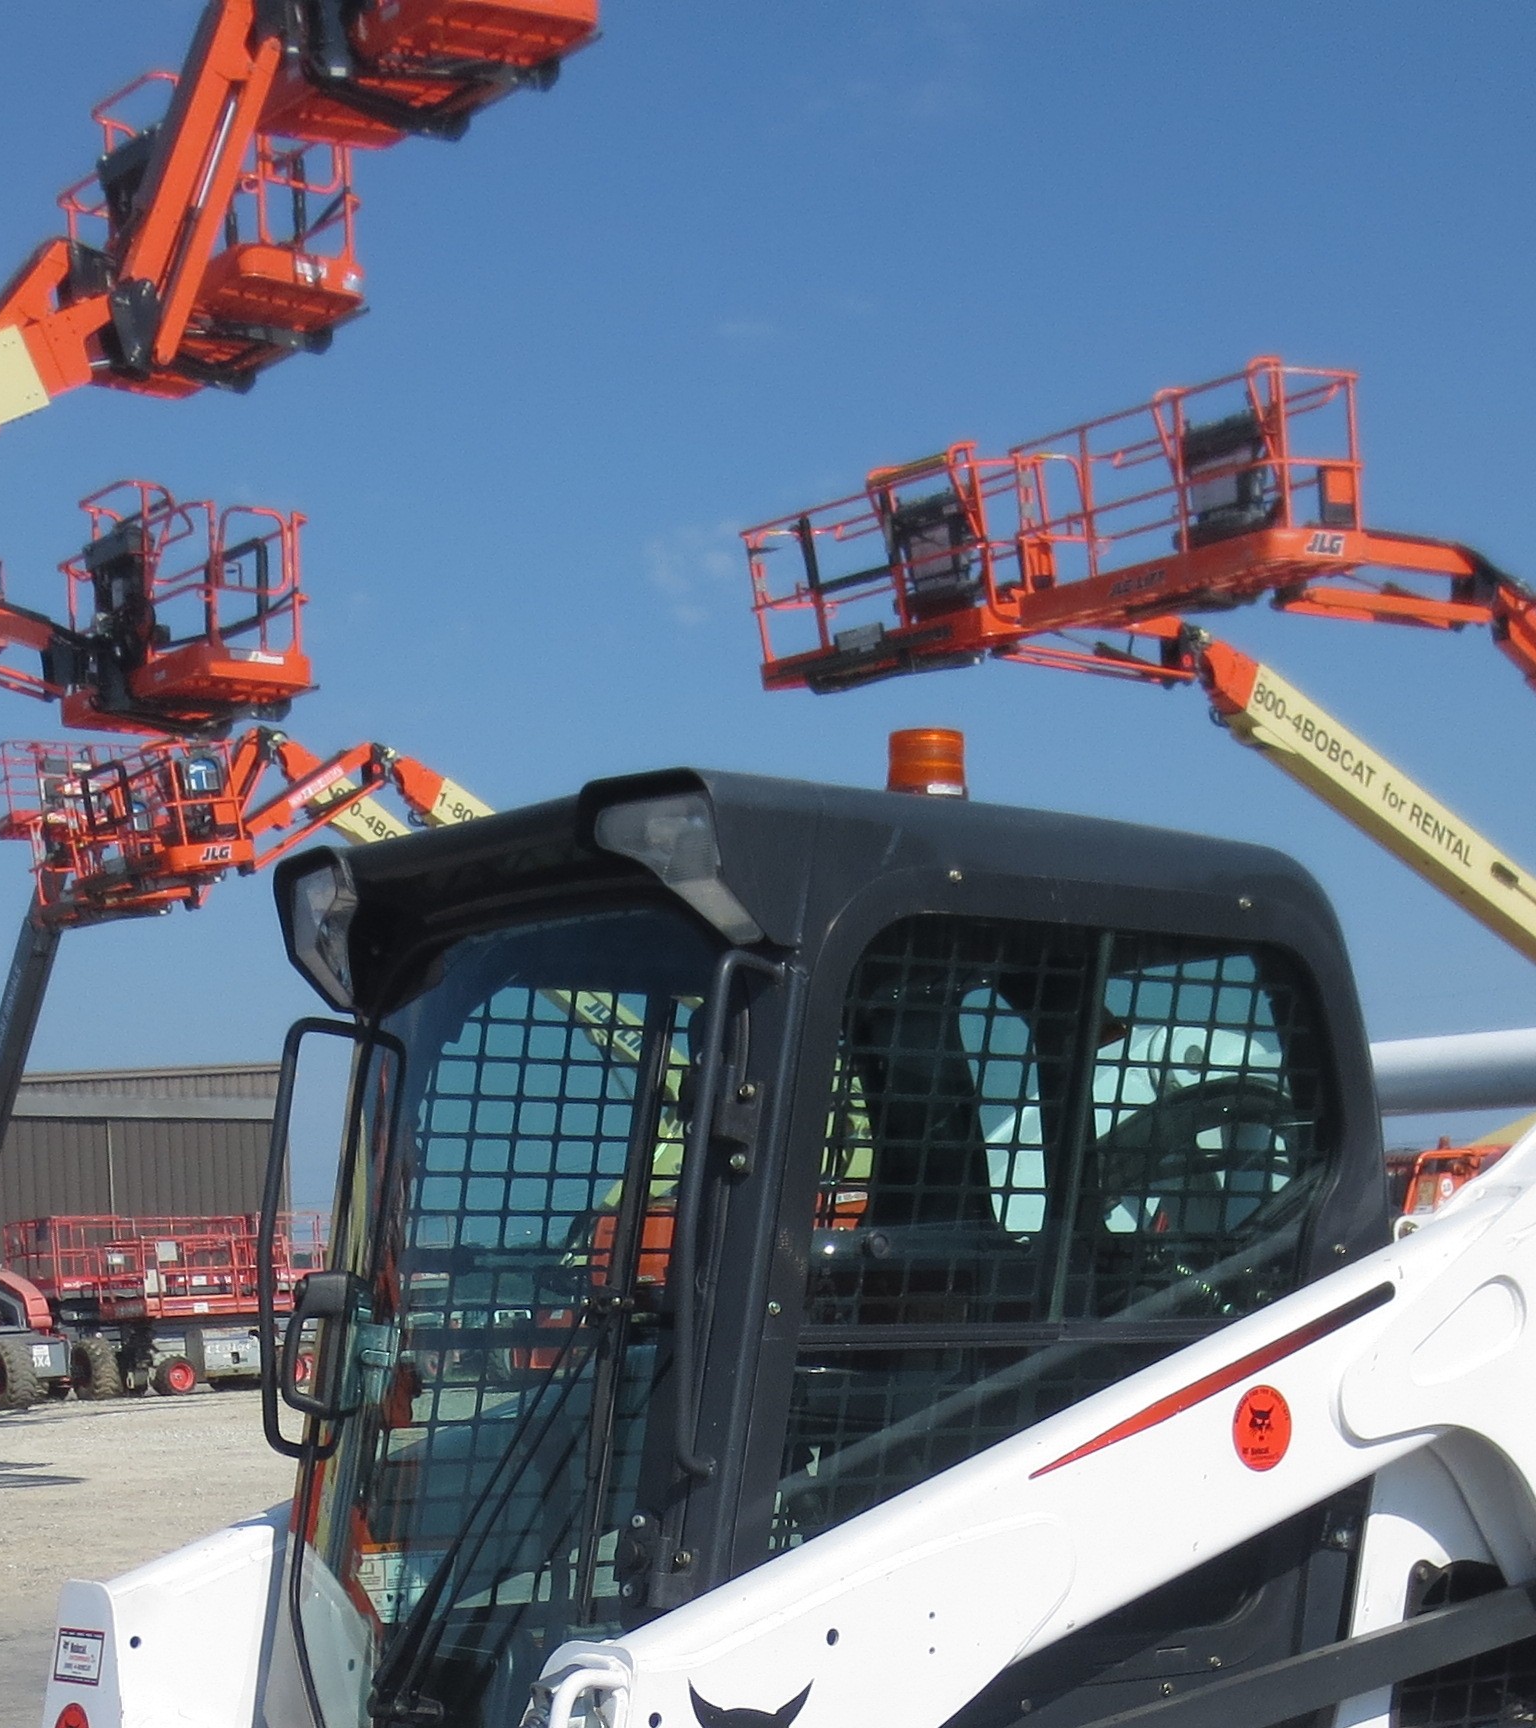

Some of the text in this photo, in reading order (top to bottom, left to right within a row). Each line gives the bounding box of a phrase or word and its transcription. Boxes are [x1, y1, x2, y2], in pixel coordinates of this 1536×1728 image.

[1306, 533, 1344, 556] JLG
[1382, 782, 1407, 815] for
[1410, 802, 1474, 867] RENTAL
[201, 846, 231, 861] JLG
